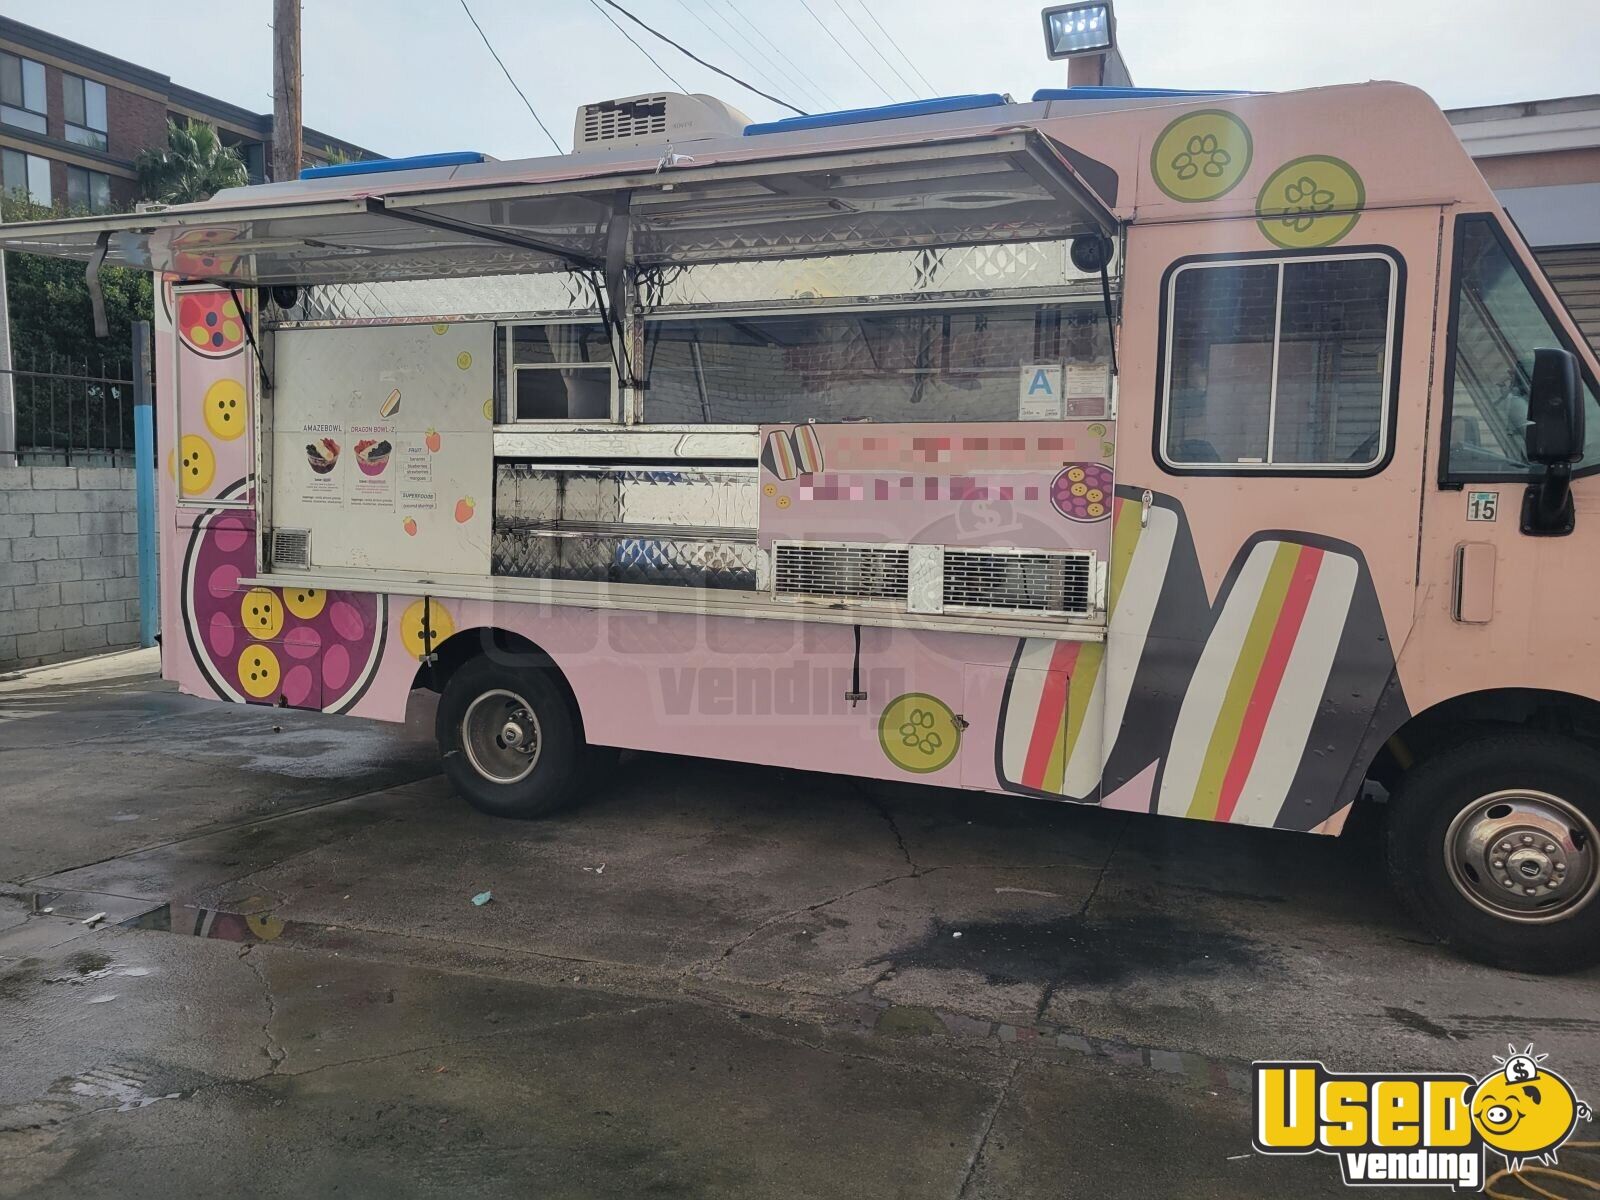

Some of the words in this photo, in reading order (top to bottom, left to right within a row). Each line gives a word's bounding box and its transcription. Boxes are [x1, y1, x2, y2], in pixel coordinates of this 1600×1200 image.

[1028, 369, 1053, 395] A
[303, 424, 342, 432] AMAZEBOWL
[1471, 500, 1495, 519] 15
